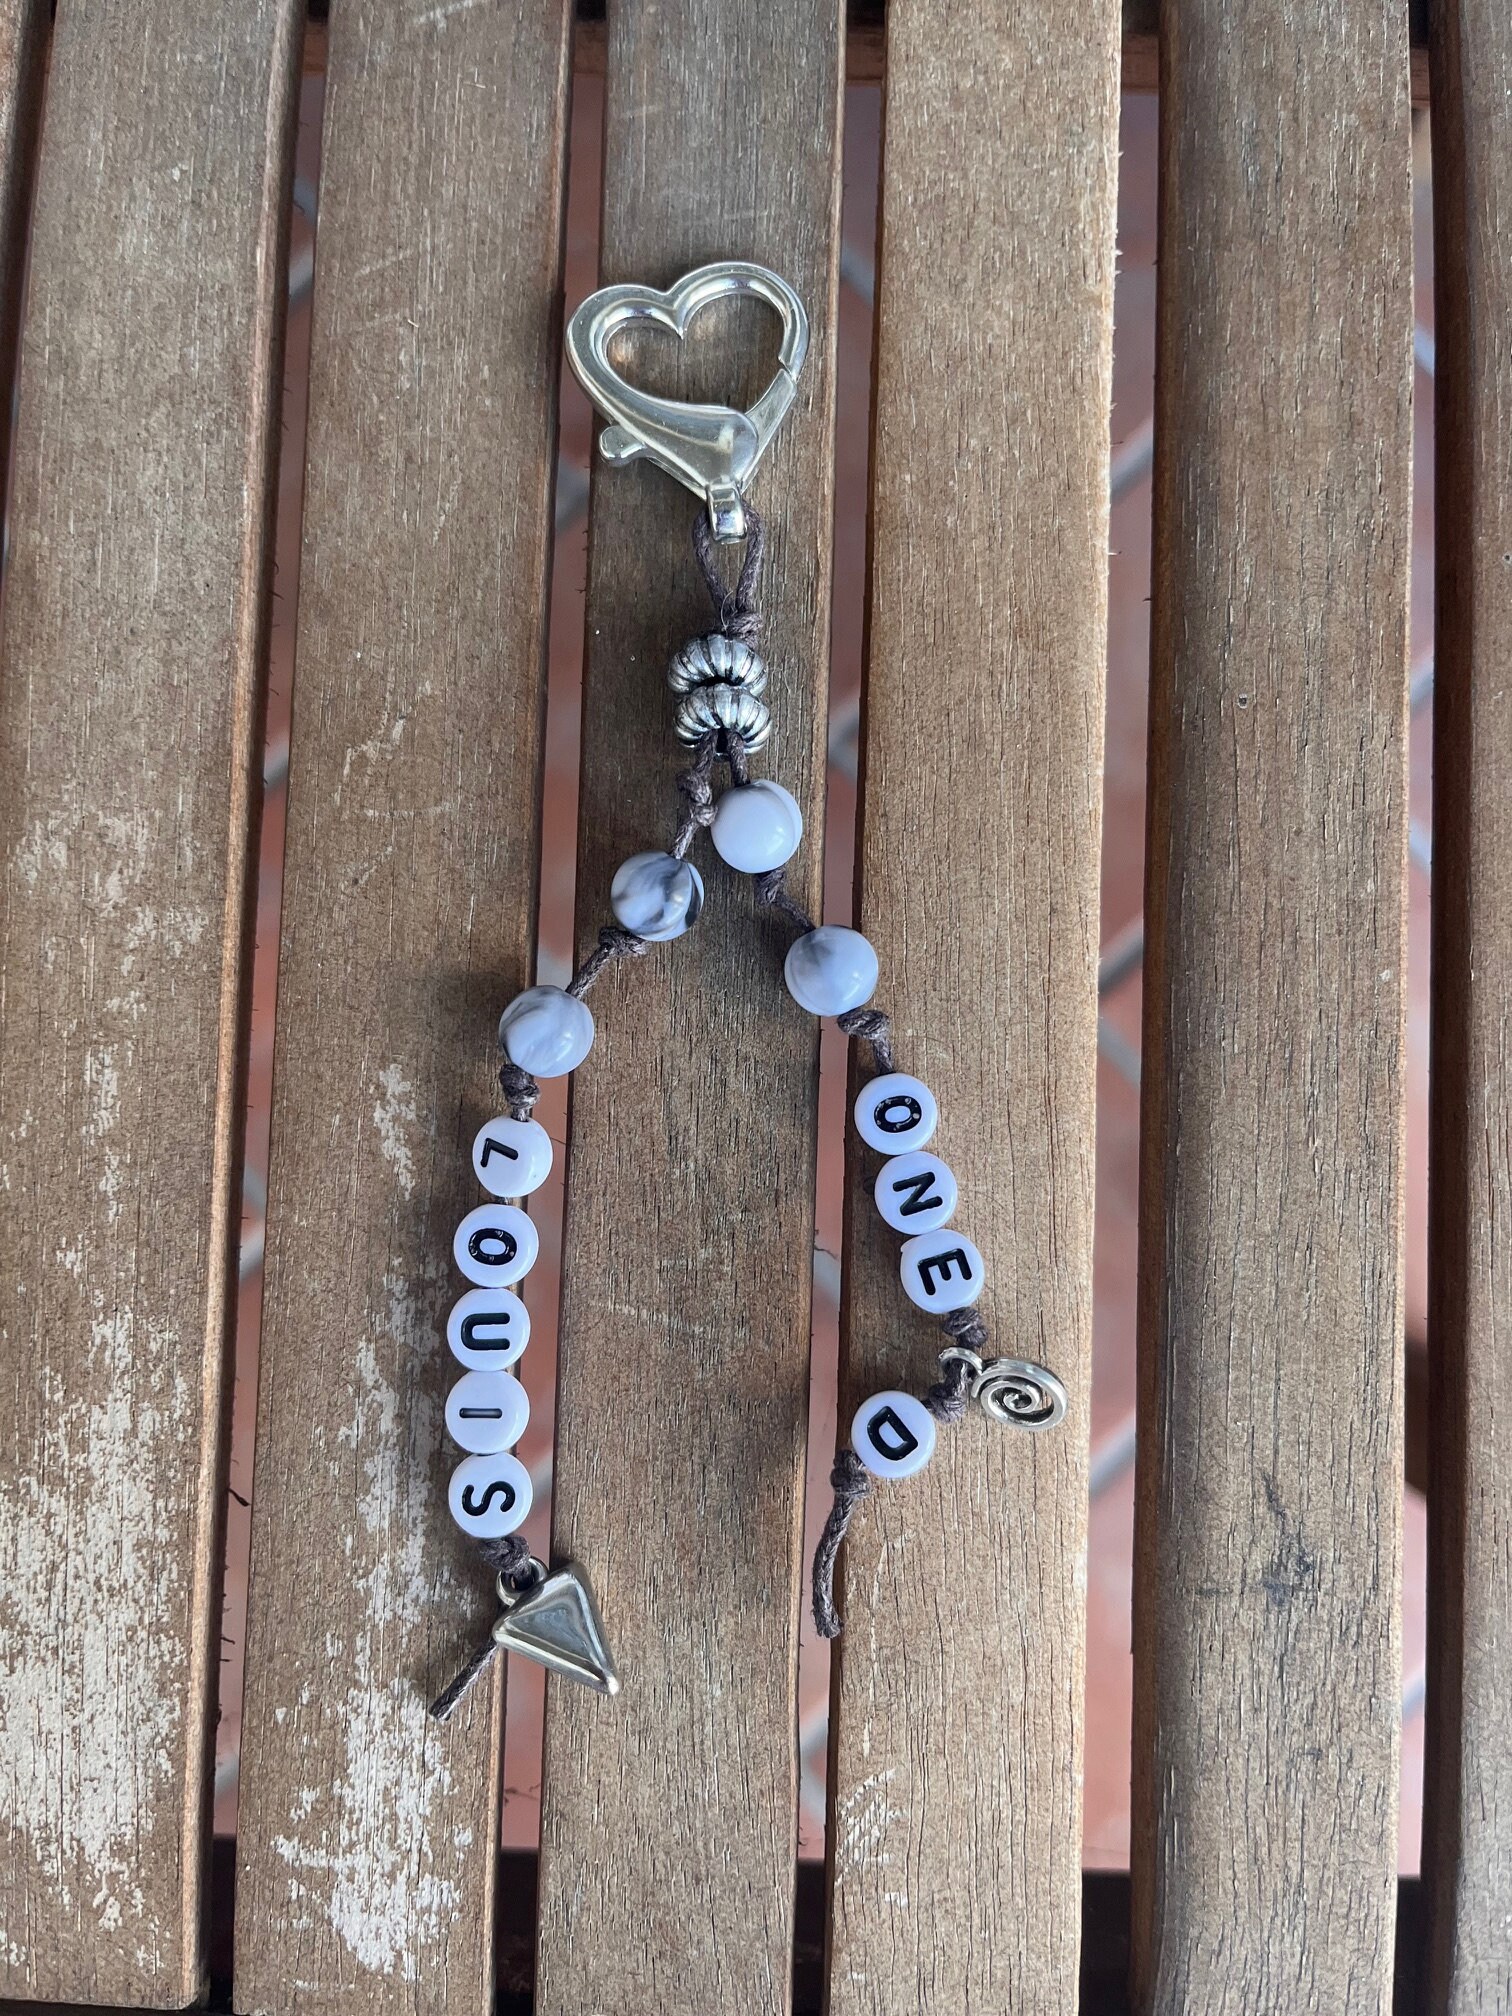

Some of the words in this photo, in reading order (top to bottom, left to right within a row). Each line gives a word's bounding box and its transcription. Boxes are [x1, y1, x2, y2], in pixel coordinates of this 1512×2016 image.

[873, 1095, 972, 1296] ONE
[459, 1137, 519, 1515] LOUIS
[866, 1405, 919, 1461] D
